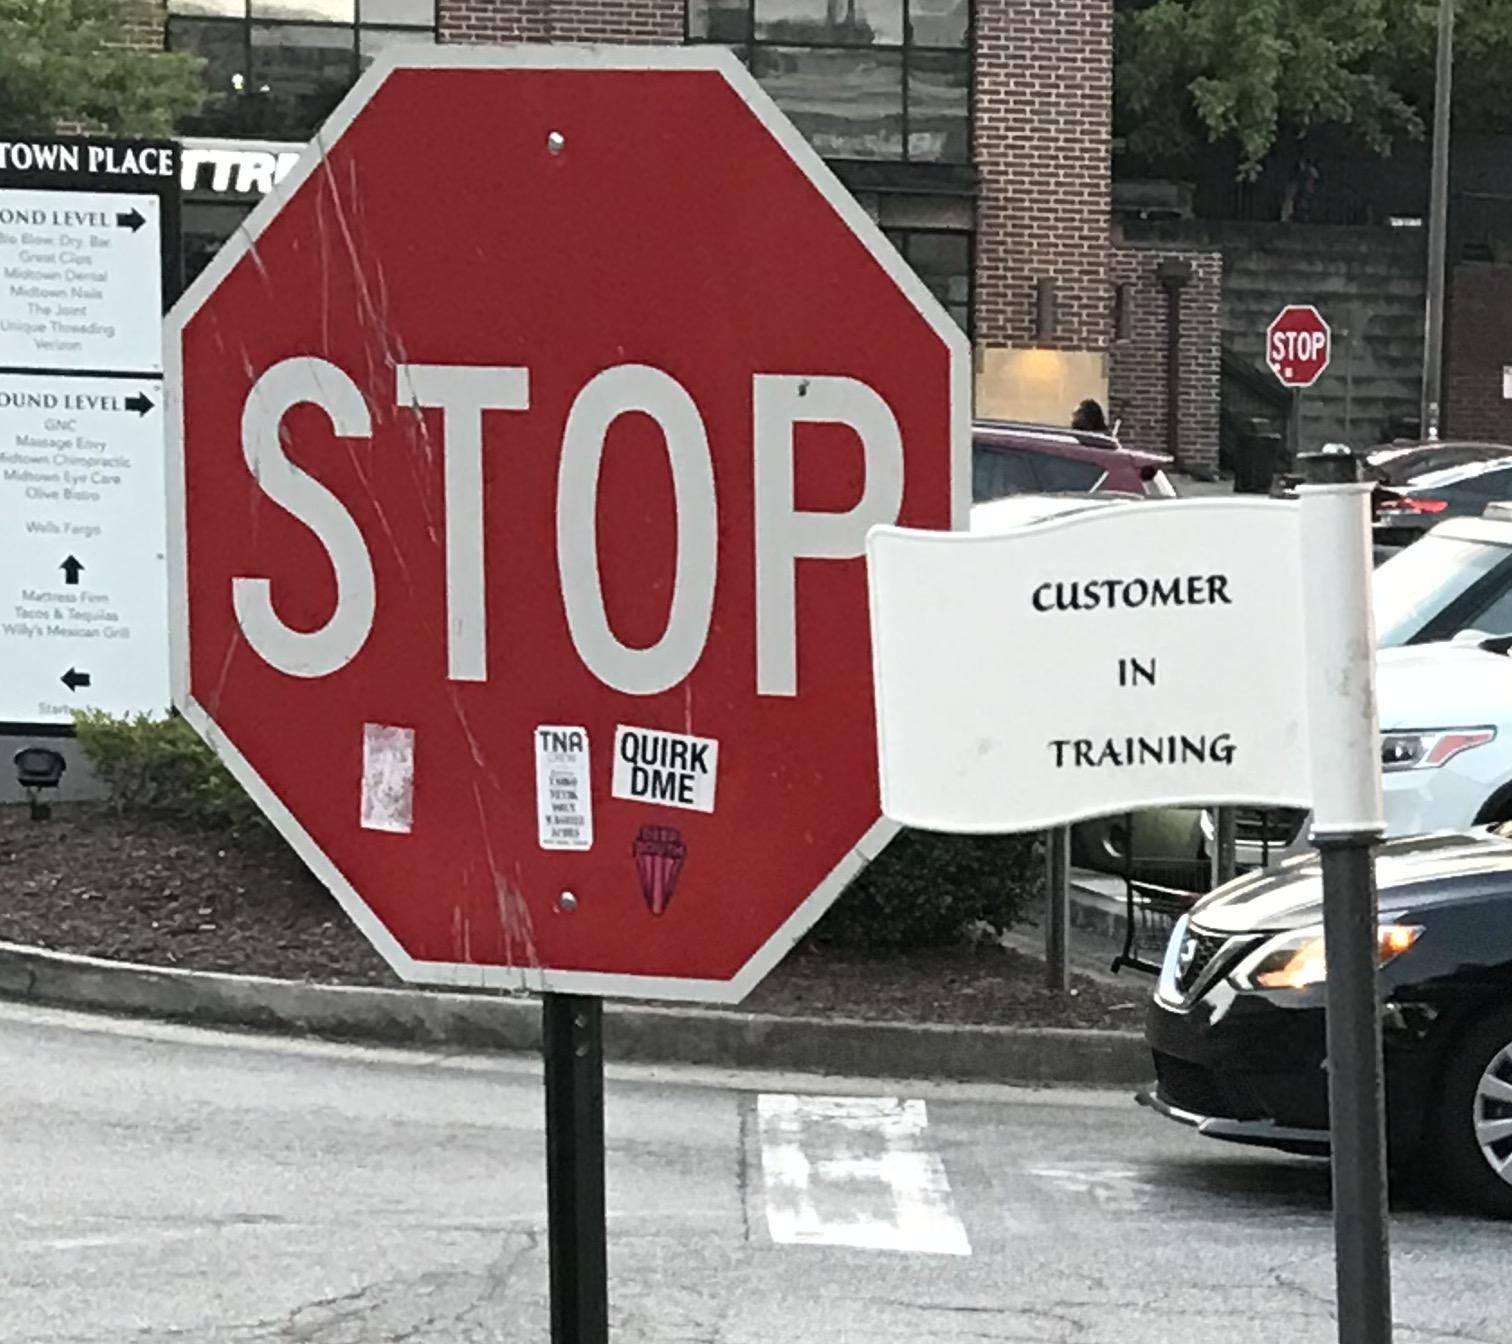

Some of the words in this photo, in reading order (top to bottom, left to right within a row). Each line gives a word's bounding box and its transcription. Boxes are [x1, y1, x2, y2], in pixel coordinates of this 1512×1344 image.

[88, 147, 174, 176] PLACE
[53, 210, 111, 227] LEVEL
[1272, 331, 1326, 362] STOP
[64, 394, 122, 412] LEVEL
[232, 356, 904, 697] STOP
[1032, 574, 1233, 612] CUSTOMER
[1118, 657, 1156, 687] IN
[538, 730, 584, 753] TNA
[620, 731, 710, 775] QUIRK
[1047, 733, 1238, 768] TRAINING
[630, 765, 695, 805] DME
